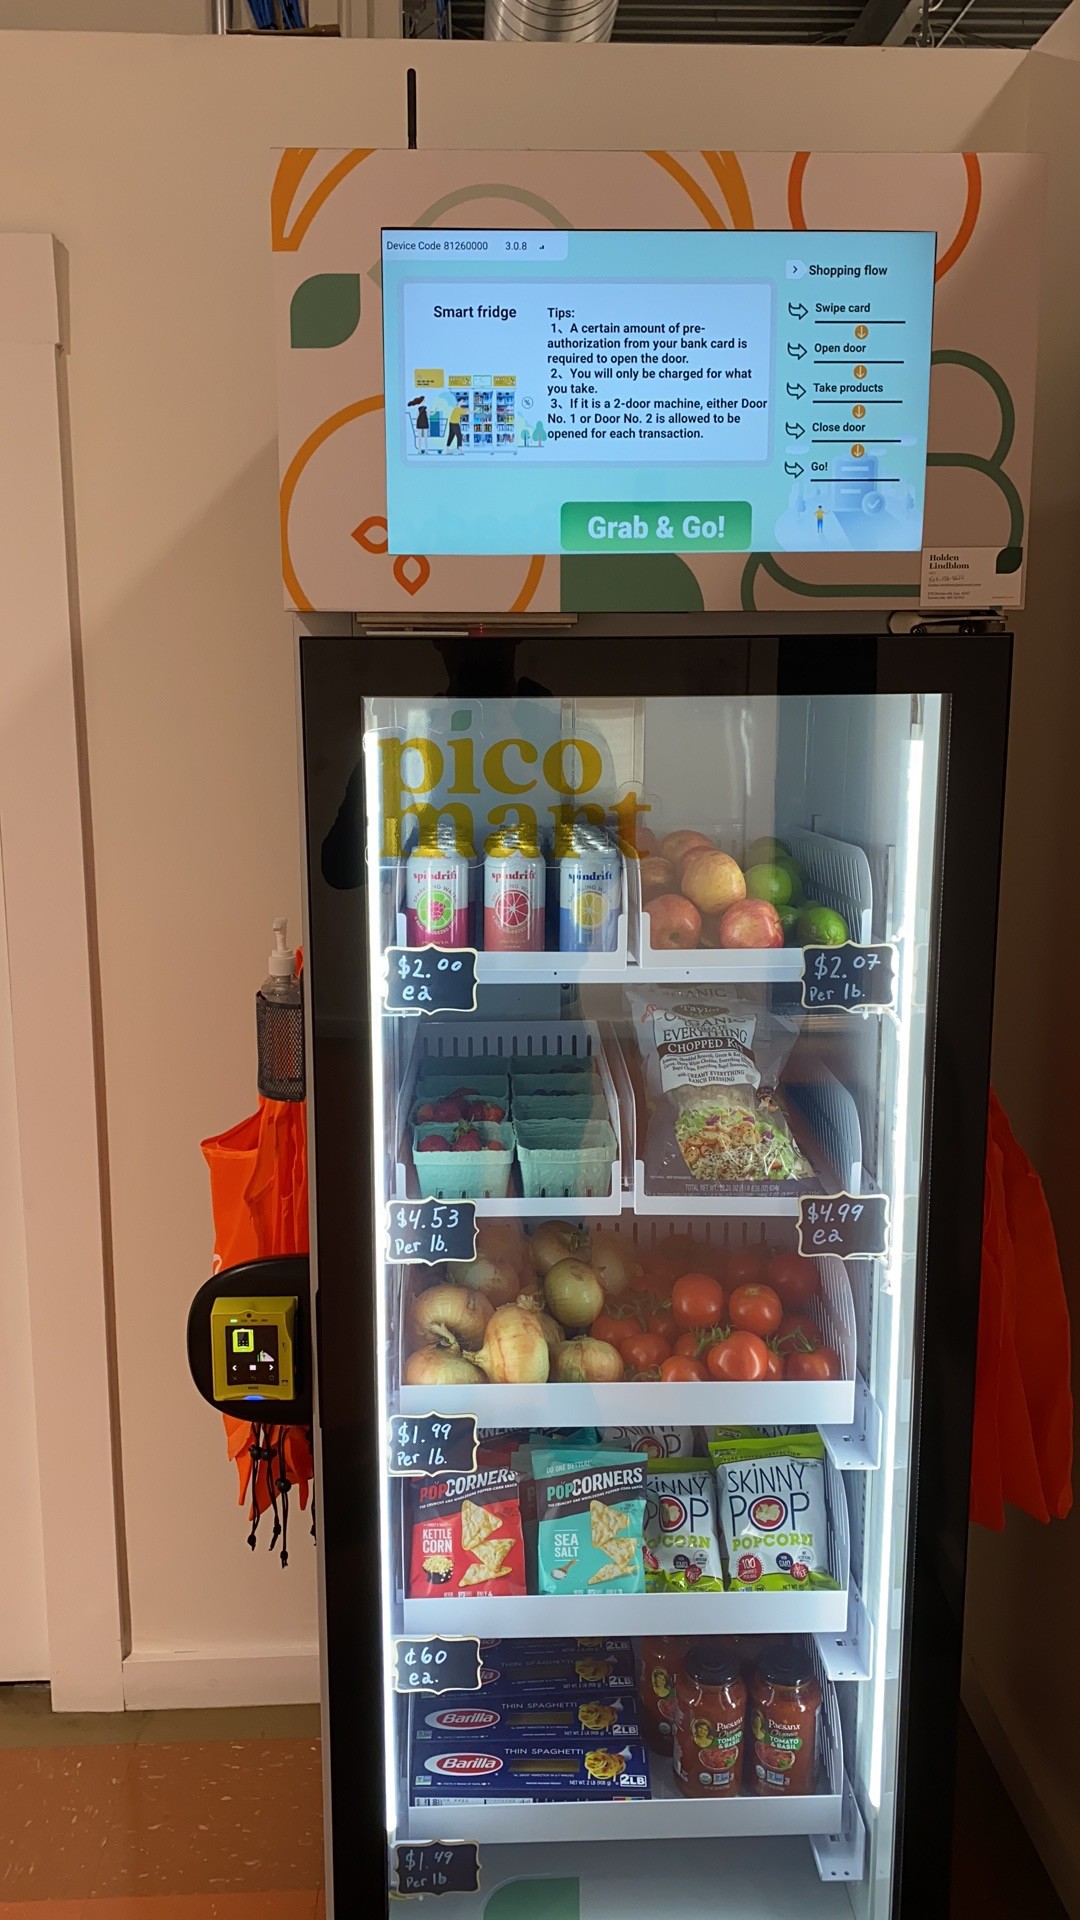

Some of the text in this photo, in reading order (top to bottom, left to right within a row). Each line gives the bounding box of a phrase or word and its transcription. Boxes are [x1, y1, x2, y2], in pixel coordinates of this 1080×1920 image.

[387, 241, 527, 250] Device Code 81260000 3.0.8
[809, 265, 888, 278] Shopping flow
[434, 305, 517, 320] Smart fridge
[548, 308, 575, 320] Tips:
[815, 303, 870, 315] Swipe card
[570, 323, 578, 333] A
[581, 322, 620, 333] certain
[623, 323, 665, 333] amount
[668, 322, 680, 333] of
[682, 324, 705, 336] pre-
[548, 338, 747, 351] authorization from your bank card is
[814, 344, 866, 355] Open door
[548, 353, 689, 366] required to open the door.
[570, 369, 591, 379] You
[594, 368, 613, 379] will
[616, 368, 638, 382] only
[642, 368, 655, 379] be
[659, 368, 703, 382] charged
[706, 368, 722, 379] for
[725, 368, 752, 379] what
[548, 383, 598, 396] you take.
[814, 383, 883, 395] Take products
[570, 399, 578, 408] If
[581, 399, 588, 409] it
[592, 399, 601, 409] is
[604, 401, 611, 409] a
[614, 398, 650, 409] 2-door
[654, 398, 703, 411] machine,
[706, 398, 737, 409] either
[741, 399, 768, 409] Door
[548, 413, 740, 424] No. 1 or Door No. 2 is allowed to be
[812, 423, 865, 432] Close door
[548, 428, 703, 441] opened for each transaction.
[811, 462, 828, 471] Go!
[588, 515, 725, 539] Grab & Go!
[378, 737, 602, 822] pico
[379, 792, 652, 858] mart
[492, 870, 536, 882] spndrift
[568, 870, 612, 883] spindrift
[398, 955, 462, 979] $2.00
[814, 952, 881, 980] $2.07
[402, 985, 432, 1001] ea
[810, 983, 865, 1001] Per lb.
[663, 1027, 747, 1043] EVERYTHING
[668, 1039, 723, 1053] CHOPPED
[397, 1206, 459, 1230] $4.53
[808, 1202, 864, 1224] $4.99
[813, 1229, 842, 1245] ea
[395, 1234, 448, 1255] Per lb.
[398, 1422, 452, 1446] $1.99
[397, 1448, 447, 1466] Per lb.
[547, 1467, 643, 1502] POPCORNERS
[728, 1463, 804, 1494] SKINNY
[419, 1468, 518, 1503] POPCORNERS
[647, 1476, 707, 1496] KINNY
[729, 1492, 810, 1536] POP
[423, 1529, 452, 1539] KETTLE
[554, 1534, 578, 1546] SEA
[423, 1540, 452, 1553] CORN
[732, 1533, 813, 1551] POPCORN
[555, 1547, 579, 1557] SALT
[742, 1558, 756, 1569] 100
[405, 1647, 447, 1665] ¢60
[409, 1672, 438, 1685] ea.
[609, 1676, 632, 1685] 2LB
[442, 1713, 494, 1724] Barilla
[613, 1724, 636, 1734] 2LB
[718, 1732, 741, 1744] TOMATO
[725, 1740, 739, 1748] BASIL
[770, 1736, 799, 1744] TOMATO
[442, 1758, 496, 1770] Barilla
[620, 1774, 645, 1785] 2LB
[406, 1850, 453, 1871] $1.49
[406, 1876, 427, 1888] Per
